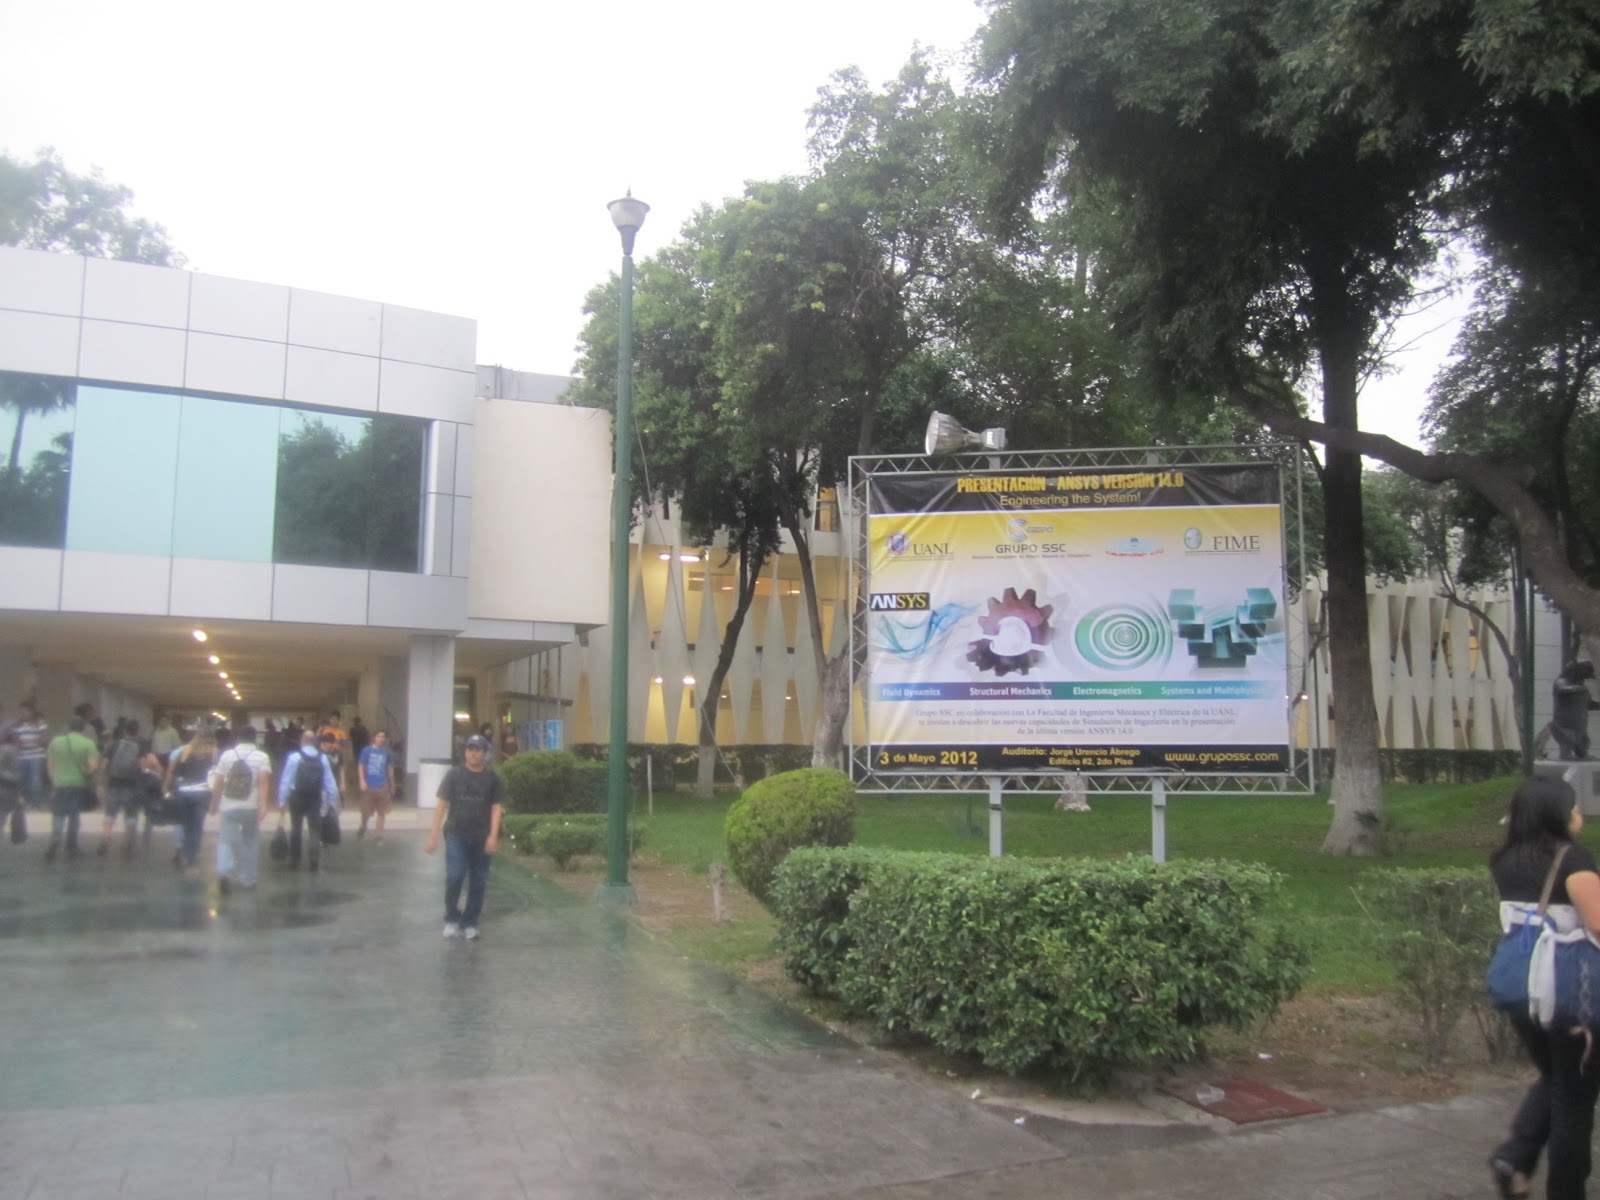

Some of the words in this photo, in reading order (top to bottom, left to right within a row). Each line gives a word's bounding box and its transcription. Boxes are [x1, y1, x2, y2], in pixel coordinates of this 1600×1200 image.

[1056, 474, 1100, 491] ANSYS
[1157, 471, 1185, 488] 14.0
[1000, 494, 1069, 507] Engineering
[1071, 493, 1091, 504] the
[1093, 491, 1142, 506] System!
[995, 543, 1038, 554] GRUPO
[1041, 543, 1067, 553] SSC
[1213, 535, 1261, 551] FIME
[912, 542, 954, 556] UANL
[870, 593, 927, 609] ANSYS
[882, 687, 902, 697] Fluid
[903, 687, 942, 698] Dynamics
[969, 686, 1009, 697] Structural
[1010, 686, 1053, 697] Mechanics
[1072, 686, 1143, 698] Electromagnetics
[1160, 686, 1195, 697] Systems
[1196, 686, 1213, 696] and
[1068, 708, 1078, 716] de
[1191, 708, 1201, 716] de
[1071, 717, 1081, 725] de
[1123, 717, 1133, 725] de
[1087, 727, 1117, 735] ANSYS
[880, 751, 890, 765] 3
[892, 753, 907, 763] de
[908, 753, 937, 765] Mayo
[940, 751, 978, 765] 2012
[1001, 747, 1048, 756] Auditorio:
[1049, 747, 1074, 758] Jorge
[1049, 757, 1081, 766] Edificio
[1096, 757, 1113, 766] 2do
[1114, 757, 1134, 766] Piso
[1164, 752, 1280, 765] www.grupossc.com
